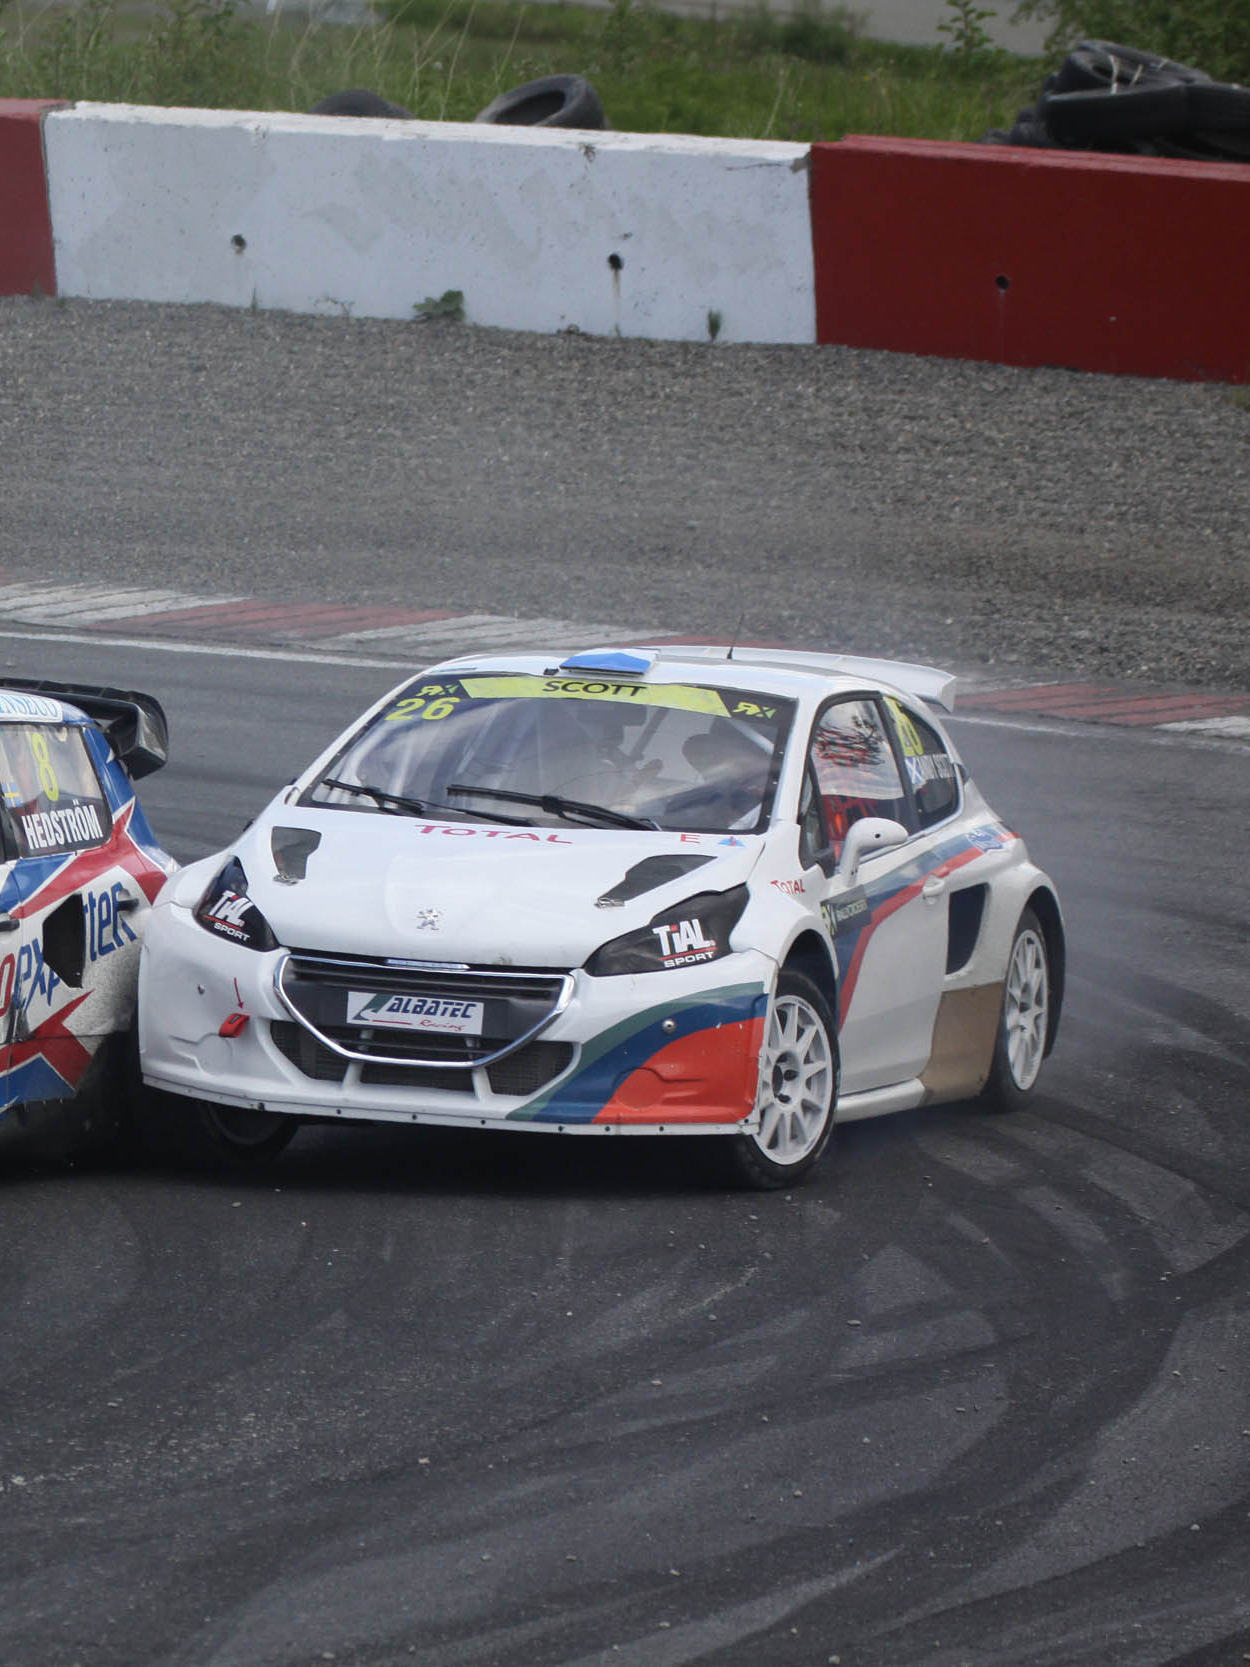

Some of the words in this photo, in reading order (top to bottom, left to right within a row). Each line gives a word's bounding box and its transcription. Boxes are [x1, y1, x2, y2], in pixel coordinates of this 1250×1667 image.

[541, 680, 647, 697] SCOTT
[385, 697, 461, 720] 26
[31, 732, 59, 802] 8
[21, 798, 103, 850] HEDSTRÖM
[414, 824, 573, 844] TOTAL
[680, 833, 701, 844] E
[770, 879, 806, 896] TOTAL
[214, 922, 250, 941] SPORT
[664, 952, 714, 968] SPORT
[387, 997, 477, 1018] ALBATEC
